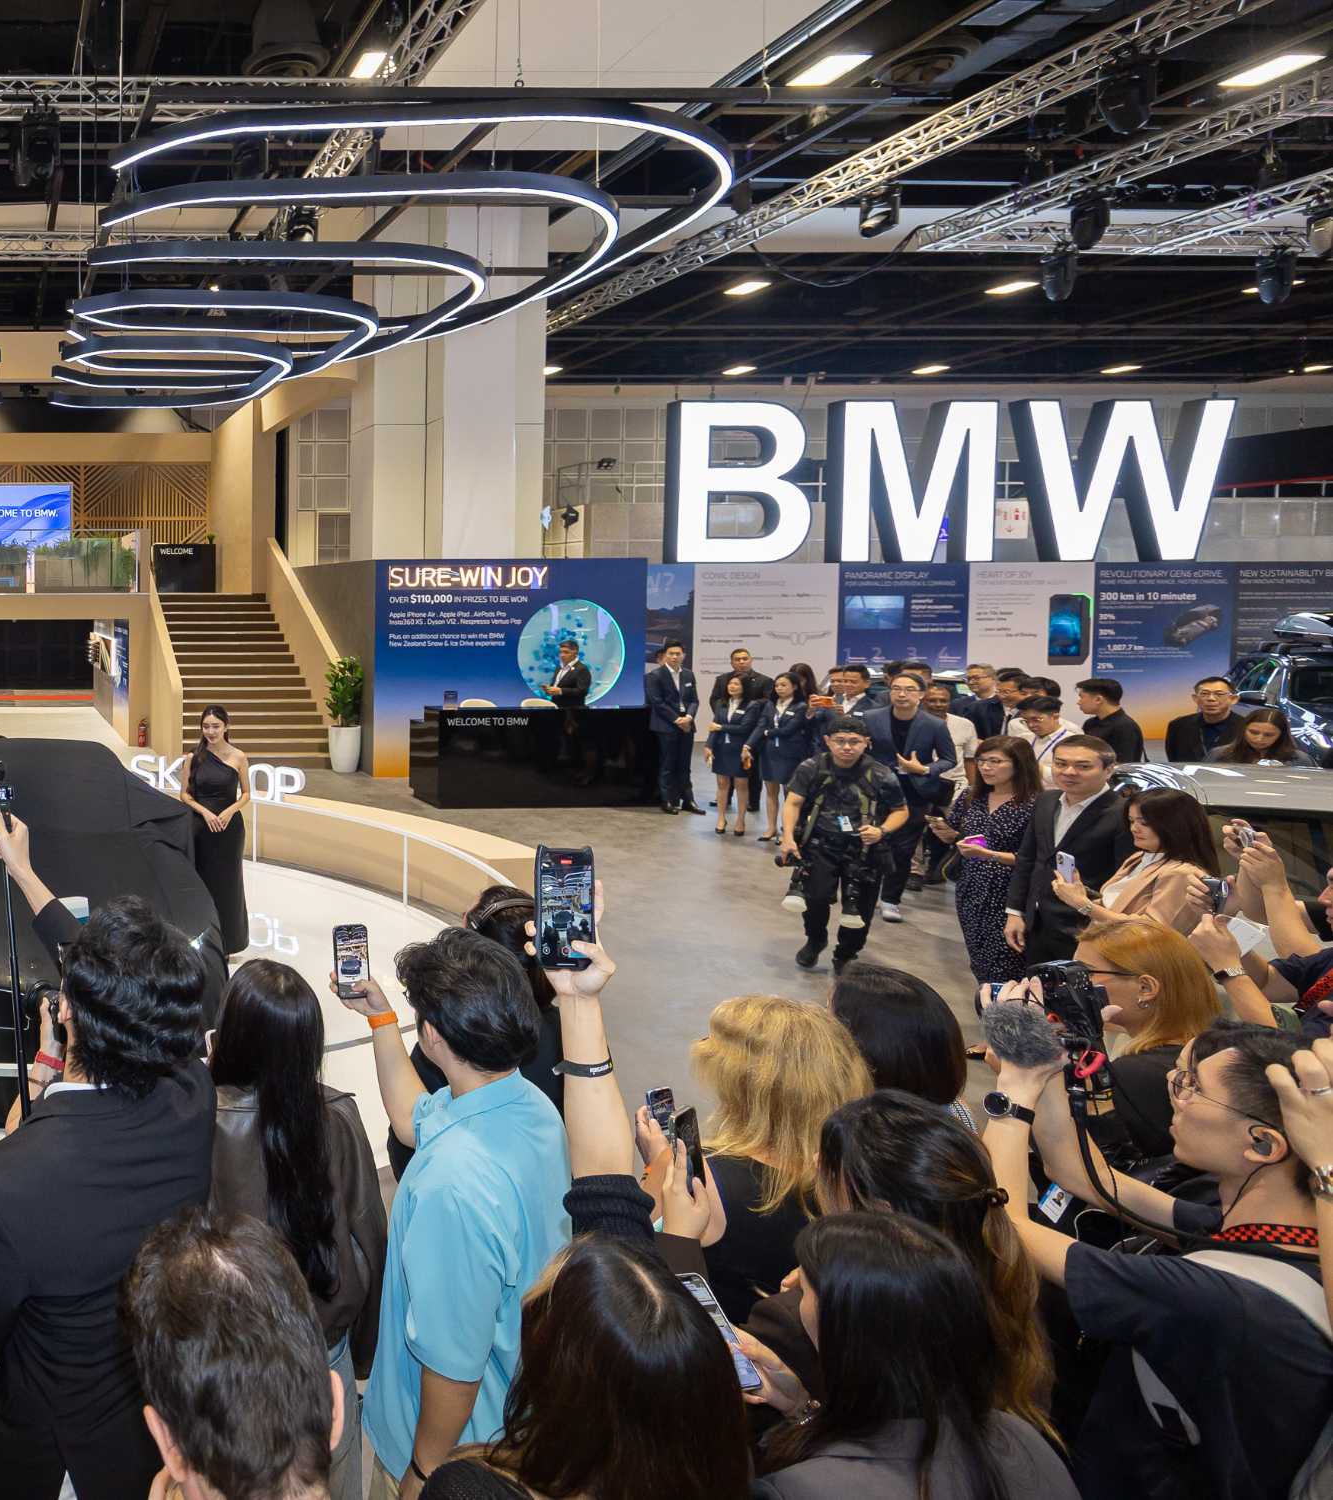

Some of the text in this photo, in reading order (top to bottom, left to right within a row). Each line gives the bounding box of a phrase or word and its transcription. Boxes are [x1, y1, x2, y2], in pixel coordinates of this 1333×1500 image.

[670, 397, 1239, 564] BMW
[20, 508, 32, 518] TO
[34, 508, 59, 518] BMW.
[159, 547, 194, 556] WELCOME
[390, 566, 548, 589] SURE-WIN JOY
[730, 571, 761, 580] DESIGN
[844, 571, 930, 580] PANORAMIC DISPLAY
[1099, 569, 1168, 578] REVOLUTIONARY
[1239, 569, 1258, 578] NEW
[1259, 569, 1324, 578] SUSTAINABILITY
[389, 594, 528, 604] OVER $110,000 IN PRIZES TO BE WON
[1099, 592, 1197, 601] 300 km in 10 minutes
[389, 610, 507, 618] Apple iPhone Air Apple iPad AirPods Pro
[388, 632, 402, 640] Plus
[403, 632, 410, 640] an
[411, 632, 438, 640] additional
[440, 632, 460, 640] chance
[468, 632, 478, 640] win
[479, 632, 488, 640] the
[489, 632, 506, 640] BMW
[388, 640, 402, 648] New
[403, 640, 427, 648] Zealand
[428, 640, 443, 648] Snow
[459, 640, 474, 648] Drive
[475, 640, 506, 648] experience
[447, 717, 529, 727] WELCOME TO BMW
[131, 754, 306, 803] SKOP
